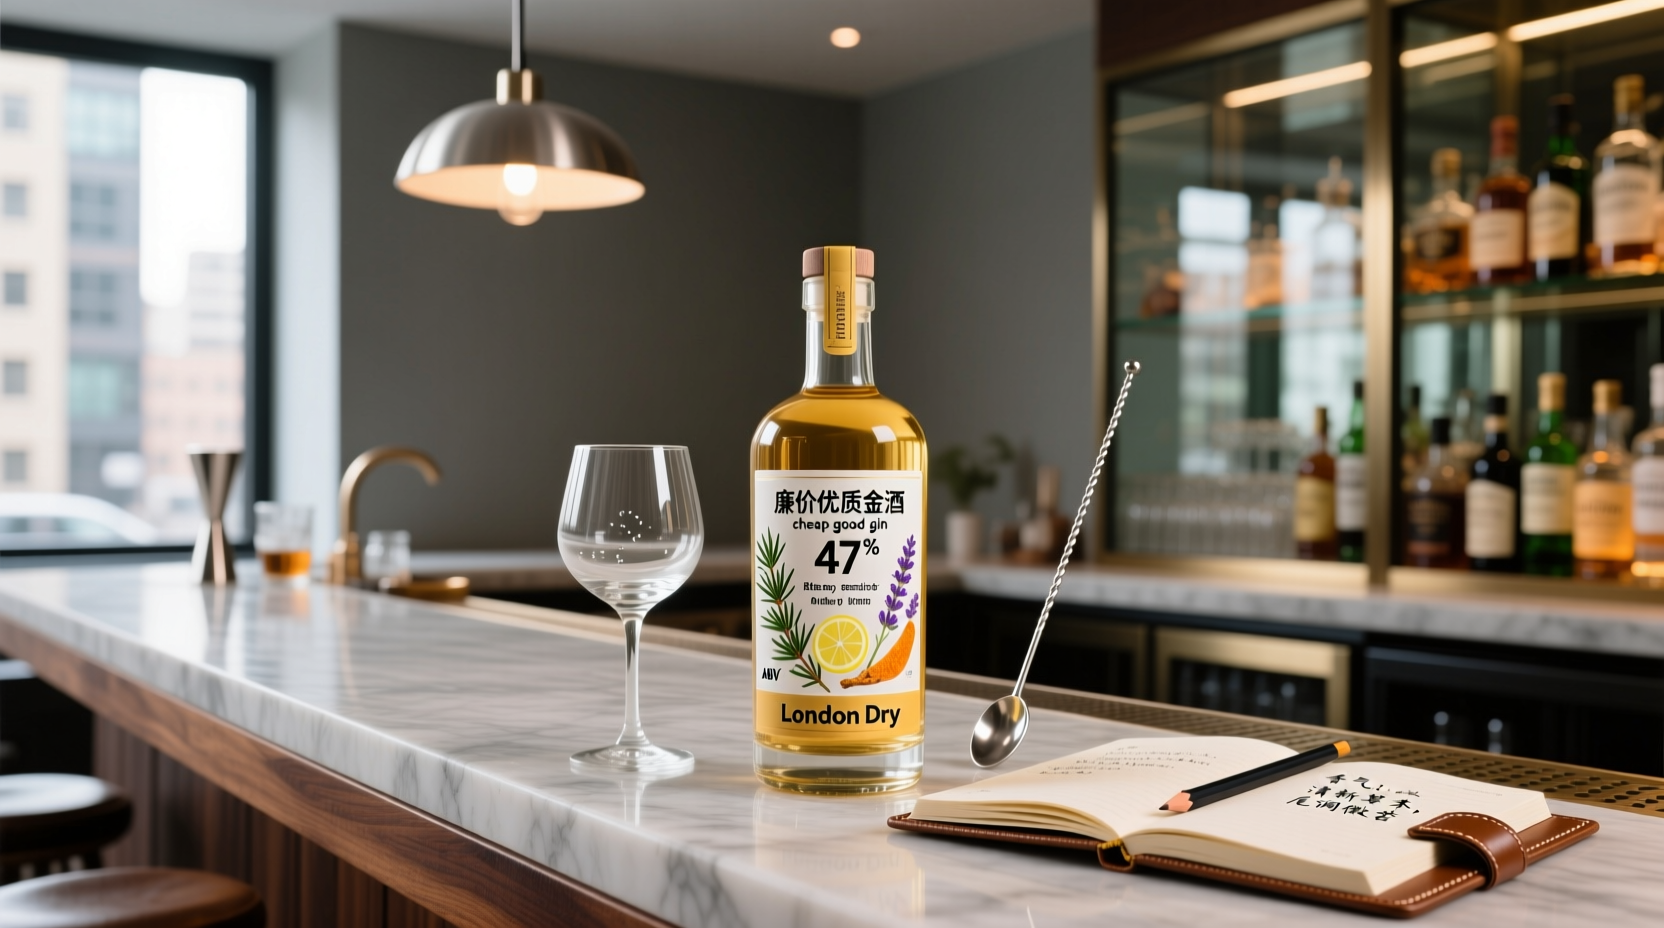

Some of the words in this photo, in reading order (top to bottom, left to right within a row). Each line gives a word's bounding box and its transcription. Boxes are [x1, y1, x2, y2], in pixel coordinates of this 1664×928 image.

[774, 489, 905, 514] 廉价优质金酒
[792, 517, 829, 533] cheap
[833, 518, 865, 533] good
[869, 517, 888, 533] gin
[781, 703, 860, 724] London
[865, 705, 901, 728] Dry
